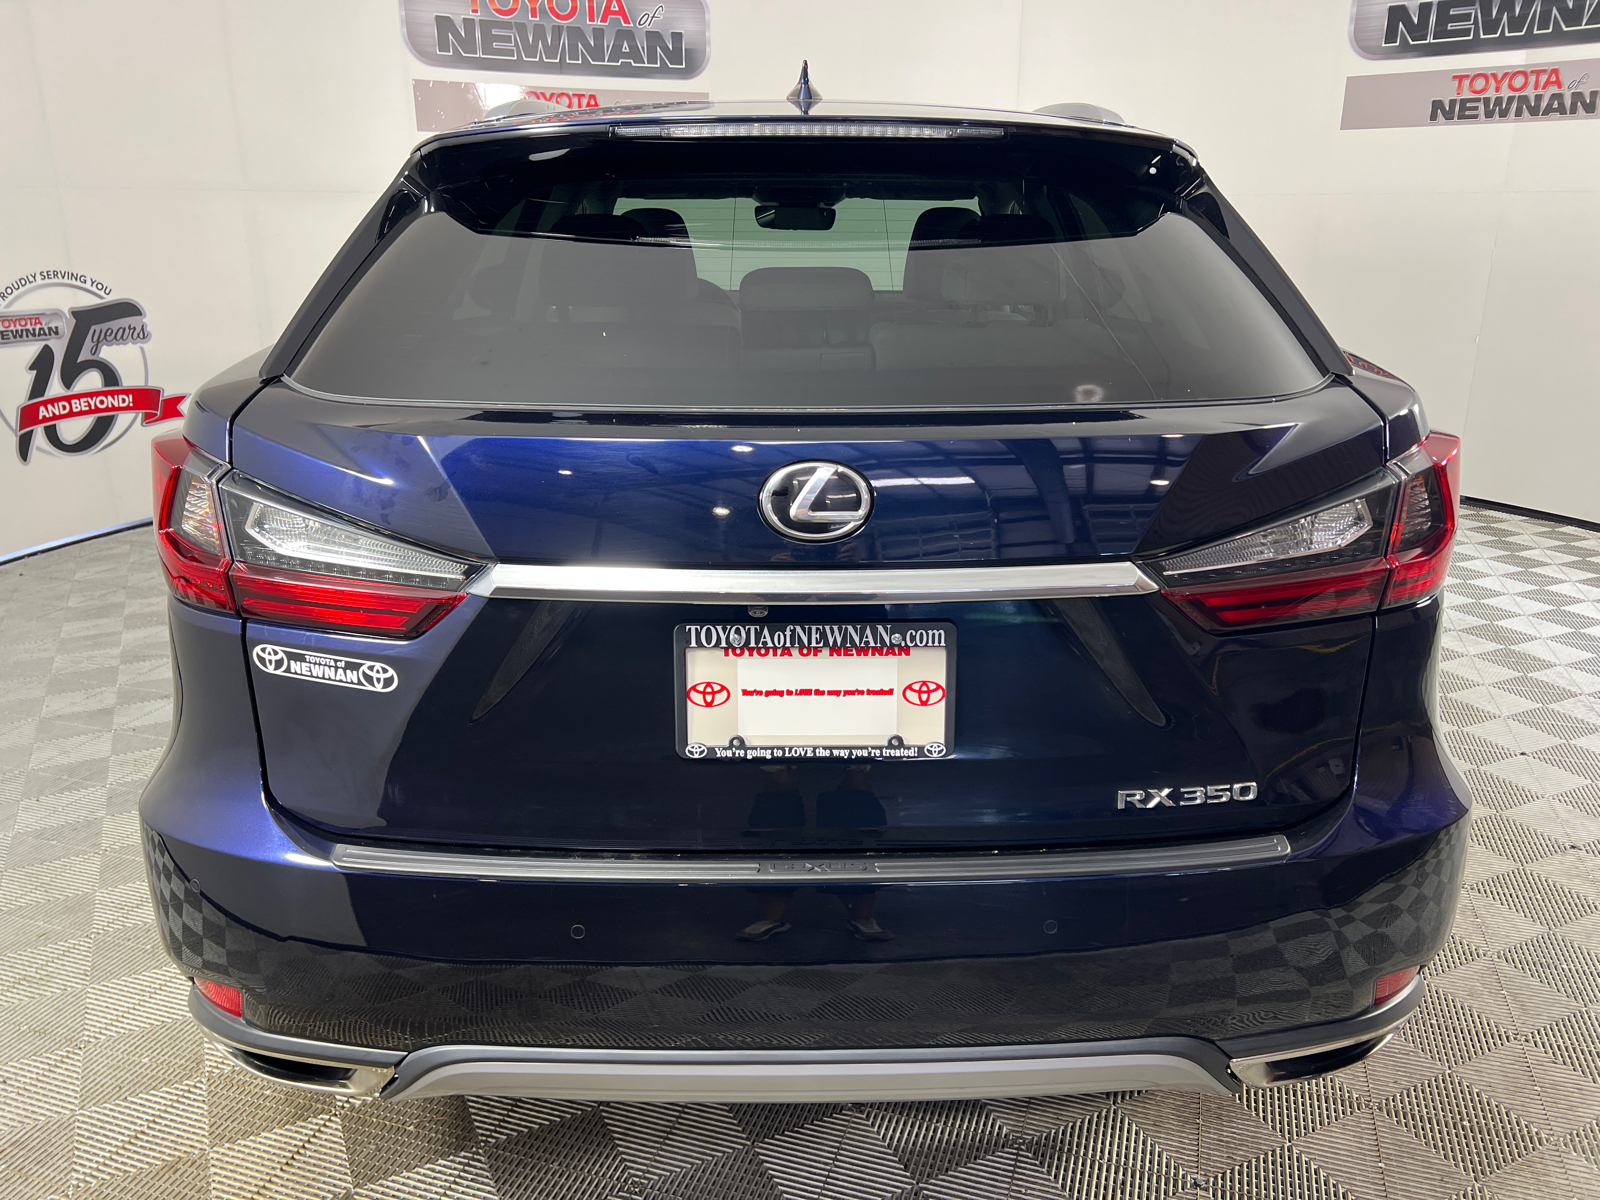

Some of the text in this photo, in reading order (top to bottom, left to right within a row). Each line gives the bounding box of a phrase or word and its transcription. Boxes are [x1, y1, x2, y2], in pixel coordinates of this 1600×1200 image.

[637, 5, 664, 28] of
[434, 14, 686, 68] NEWNAN
[1452, 67, 1590, 97] TOYOTA of
[519, 90, 600, 109] OYOTA
[1429, 90, 1600, 123] NEWNAN
[0, 269, 112, 306] ROUDLY SERVING YOU
[0, 316, 43, 329] OYOTA
[0, 326, 59, 341] EWNAN
[91, 323, 149, 356] years
[18, 301, 143, 463] 15
[38, 394, 134, 420] AND BEYOND!
[304, 655, 346, 668] TOYOTA of
[723, 646, 911, 657] TOYOTA OF NEWNAN
[290, 660, 358, 683] NEWNAN
[794, 688, 813, 696] LOVE
[714, 746, 919, 760] You're going to LOVE the way you're treated!
[1117, 781, 1258, 810] RX 350
